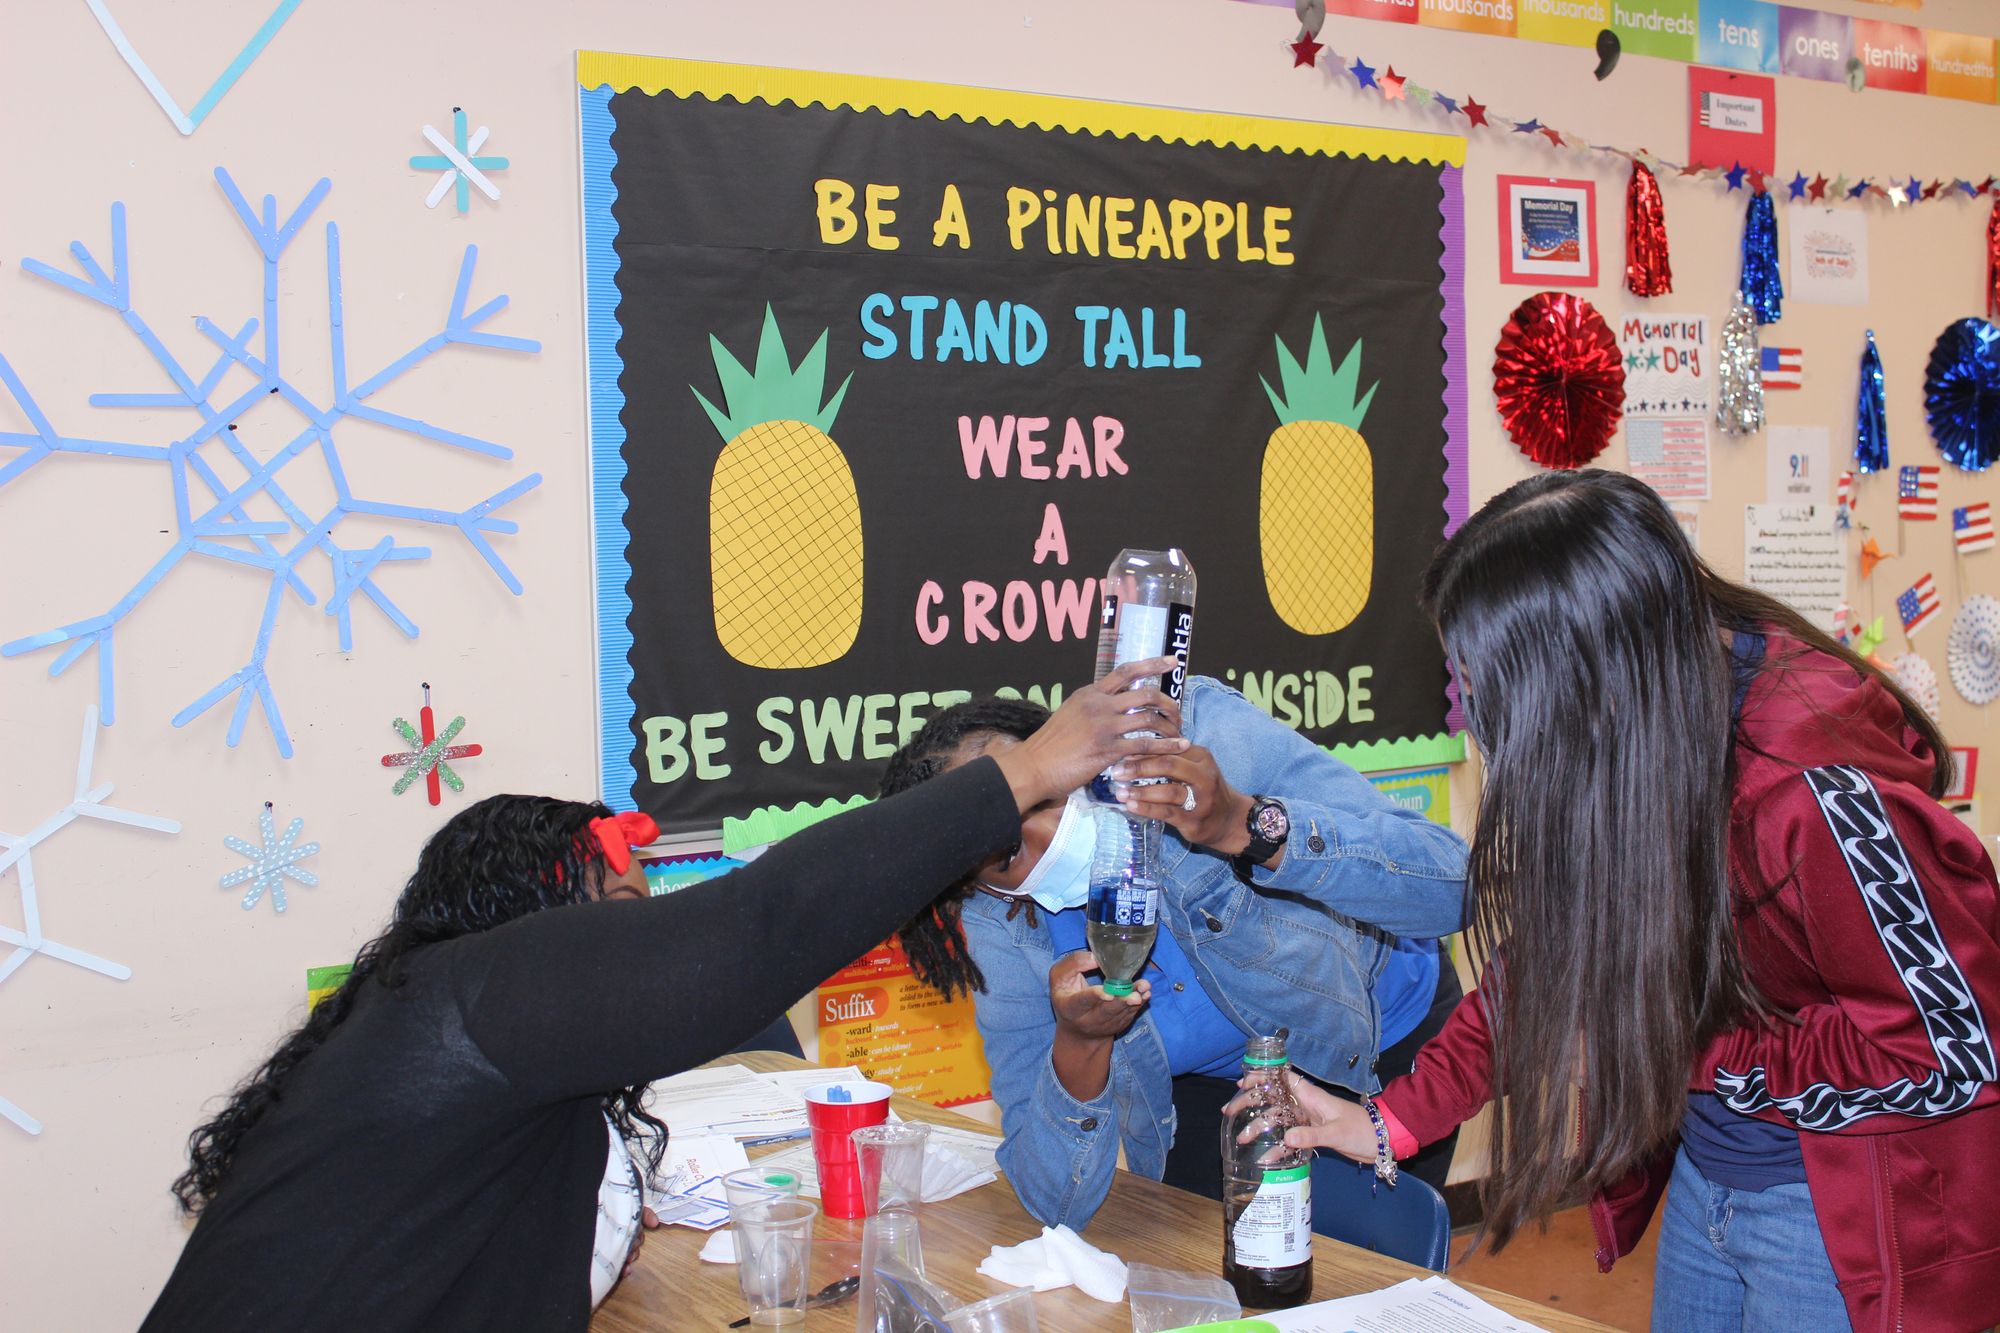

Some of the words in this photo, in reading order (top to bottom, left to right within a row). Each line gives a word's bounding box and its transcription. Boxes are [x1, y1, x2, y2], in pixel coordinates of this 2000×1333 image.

[1614, 3, 1696, 36] hundreds
[1718, 18, 1760, 48] tens
[1795, 34, 1840, 61] ones
[1863, 41, 1919, 73] tenths
[1930, 56, 1995, 79] hundredths
[1716, 98, 1756, 114] Important
[1725, 115, 1748, 127] Dates
[814, 178, 900, 251] BE
[933, 184, 971, 249] A
[1524, 200, 1559, 211] Memorial
[1559, 202, 1574, 214] Day
[860, 292, 1048, 367] STAND
[1075, 305, 1202, 369] TALL
[1623, 318, 1703, 345] Memorial
[1663, 346, 1702, 378] Day
[957, 415, 1129, 481] WEAR
[1032, 503, 1069, 566] A
[1170, 613, 1192, 709] sentia
[642, 710, 732, 784] BE
[825, 992, 876, 1022] Suffix
